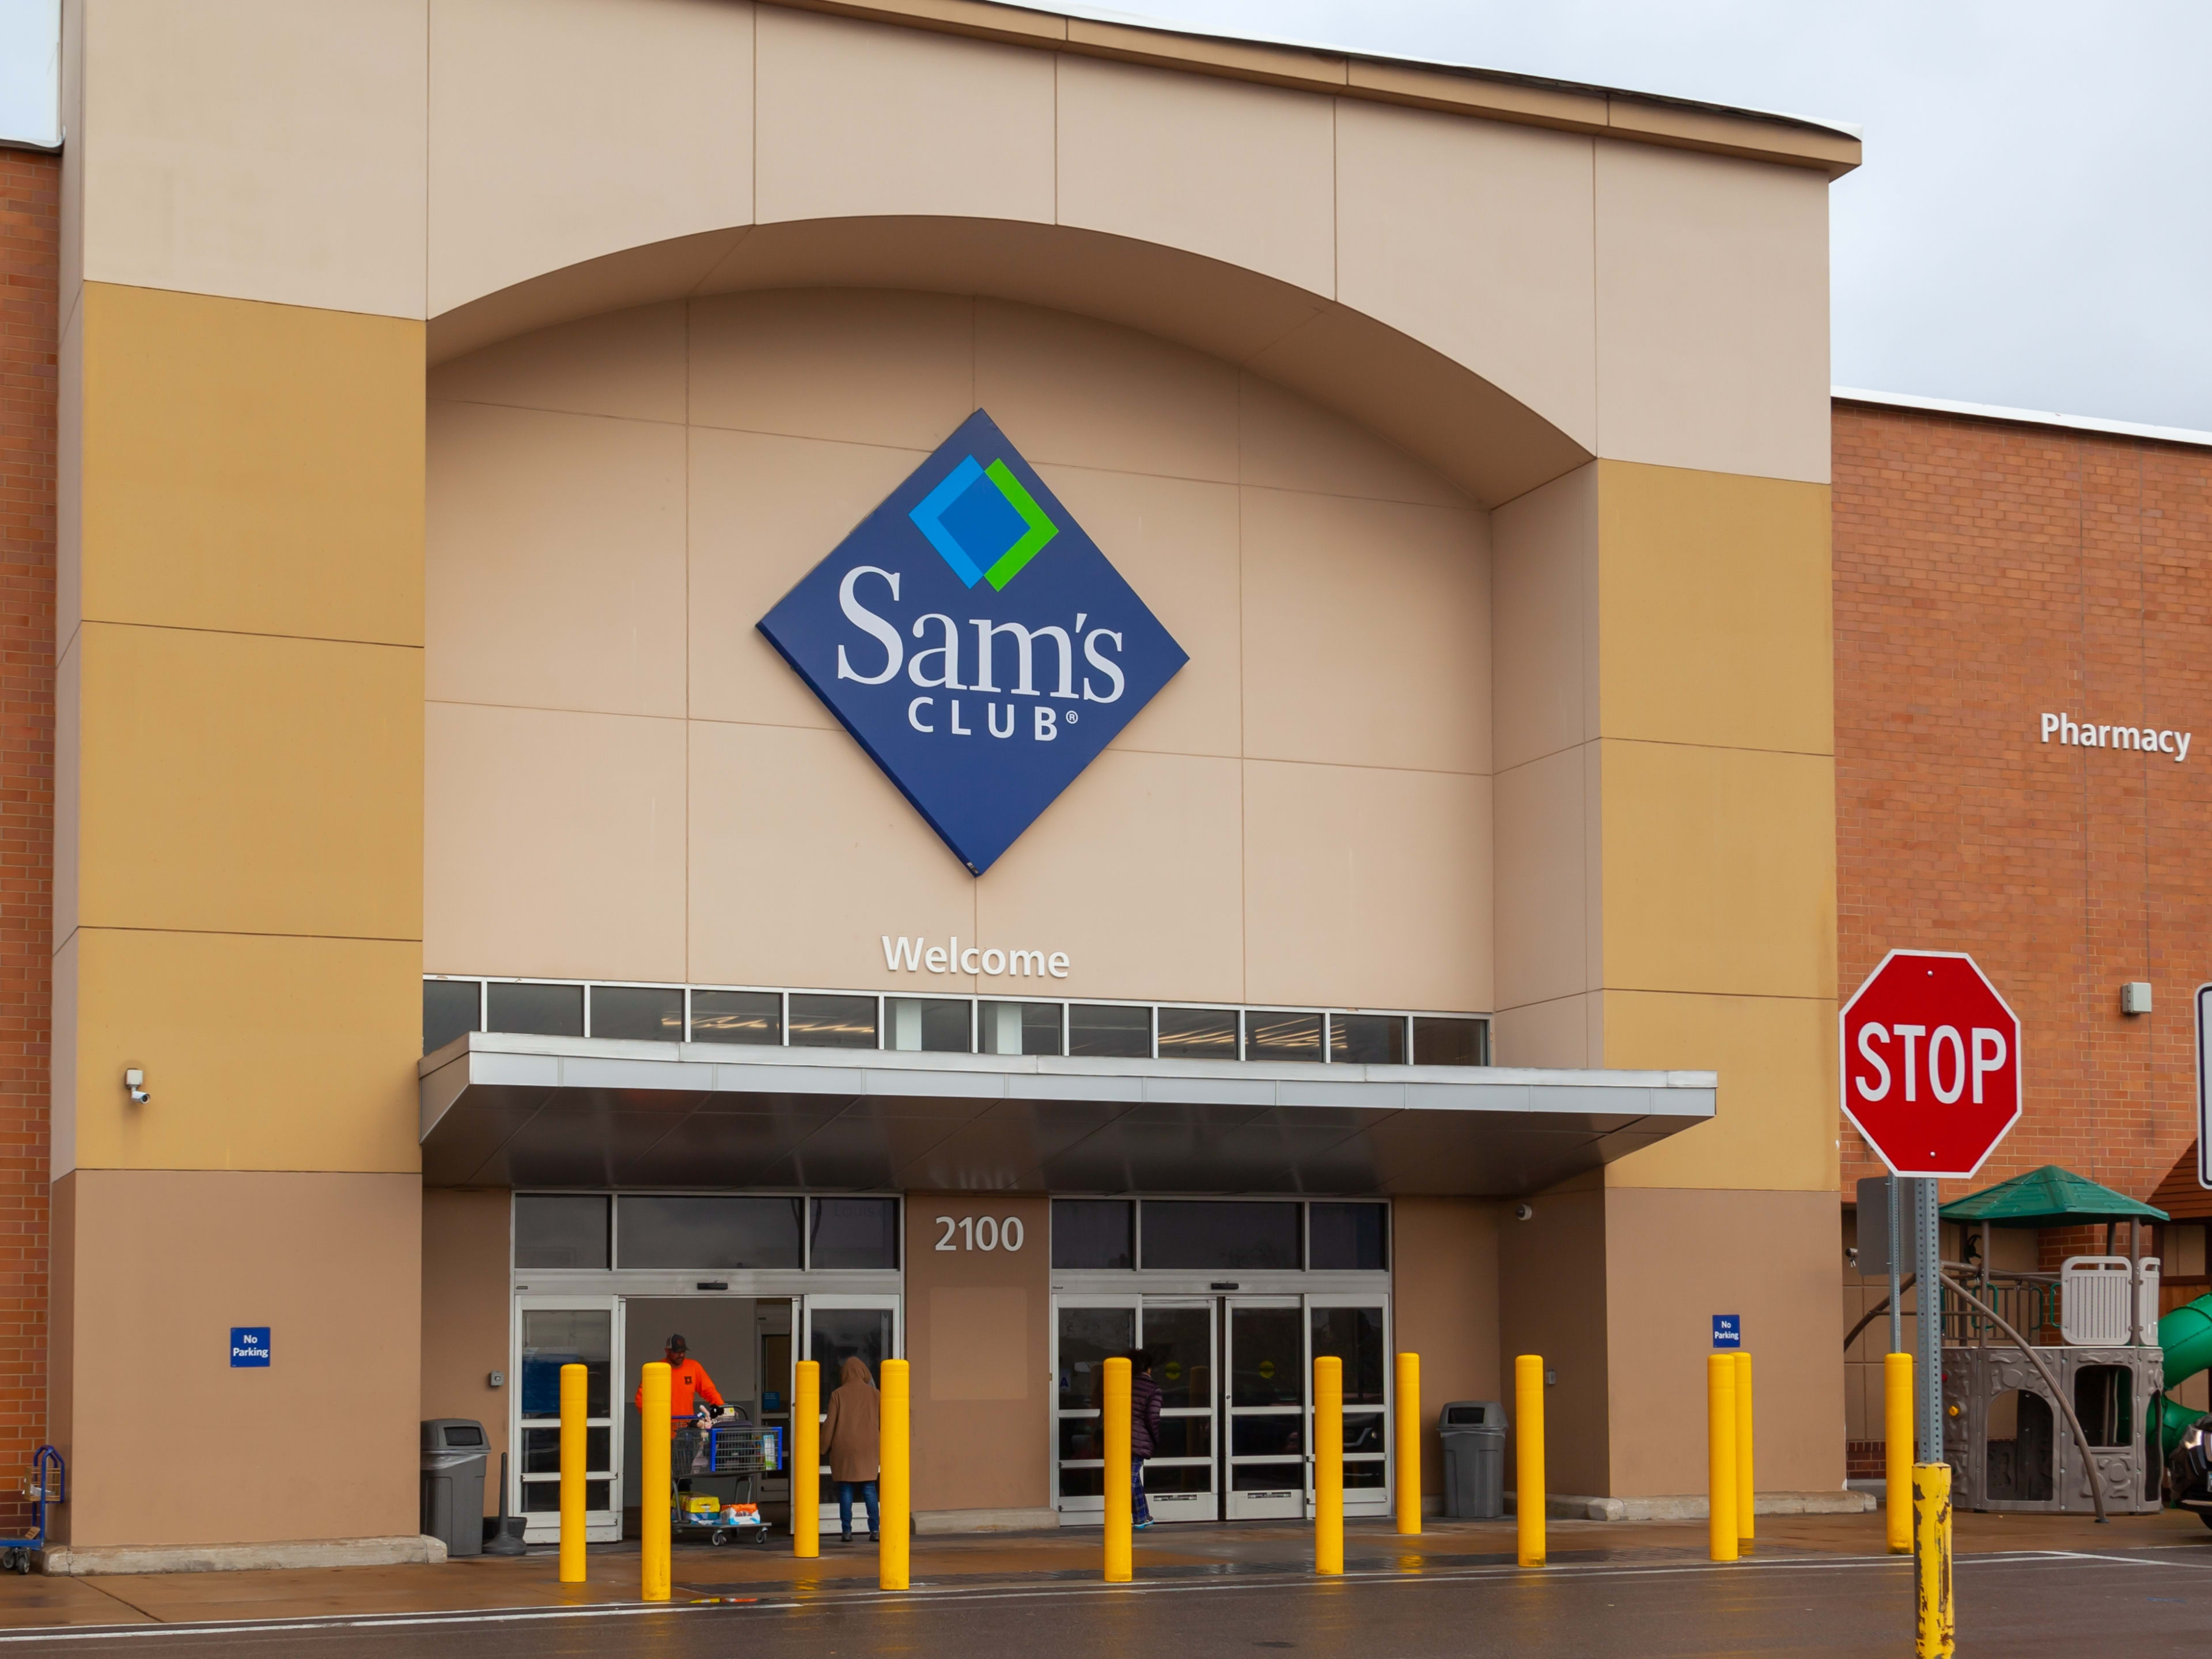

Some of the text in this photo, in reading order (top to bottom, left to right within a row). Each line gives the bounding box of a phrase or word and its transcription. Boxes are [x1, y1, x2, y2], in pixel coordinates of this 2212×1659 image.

[837, 565, 1125, 703] Sam's
[2041, 712, 2191, 762] Pharmacy
[881, 935, 1070, 978] Welcome
[1855, 1021, 2007, 1104] STOP
[935, 1216, 1024, 1251] 2100
[233, 1347, 269, 1358] Parking
[244, 1335, 258, 1343] No
[1714, 1331, 1738, 1340] Parking
